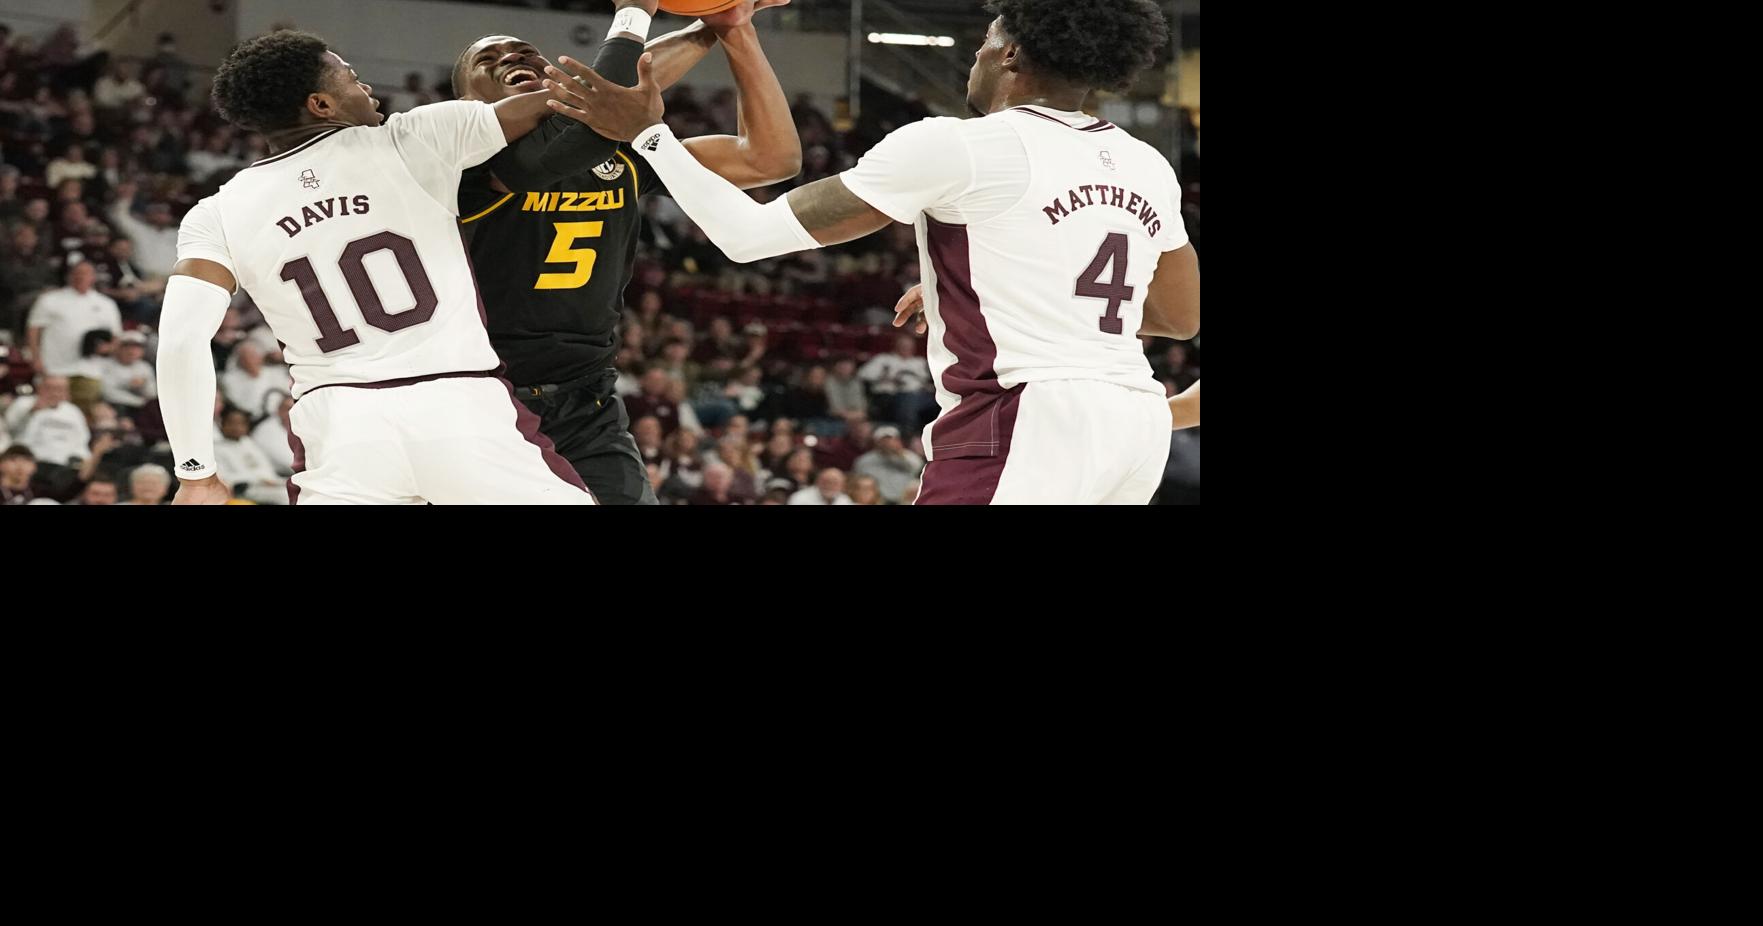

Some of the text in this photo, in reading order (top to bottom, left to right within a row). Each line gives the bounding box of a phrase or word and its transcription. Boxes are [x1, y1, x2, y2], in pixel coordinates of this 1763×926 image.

[276, 195, 370, 238] DAVIS
[1042, 184, 1161, 238] MATTHEWS
[533, 220, 604, 290] 5
[1074, 231, 1135, 335] 4
[279, 230, 439, 354] 10
